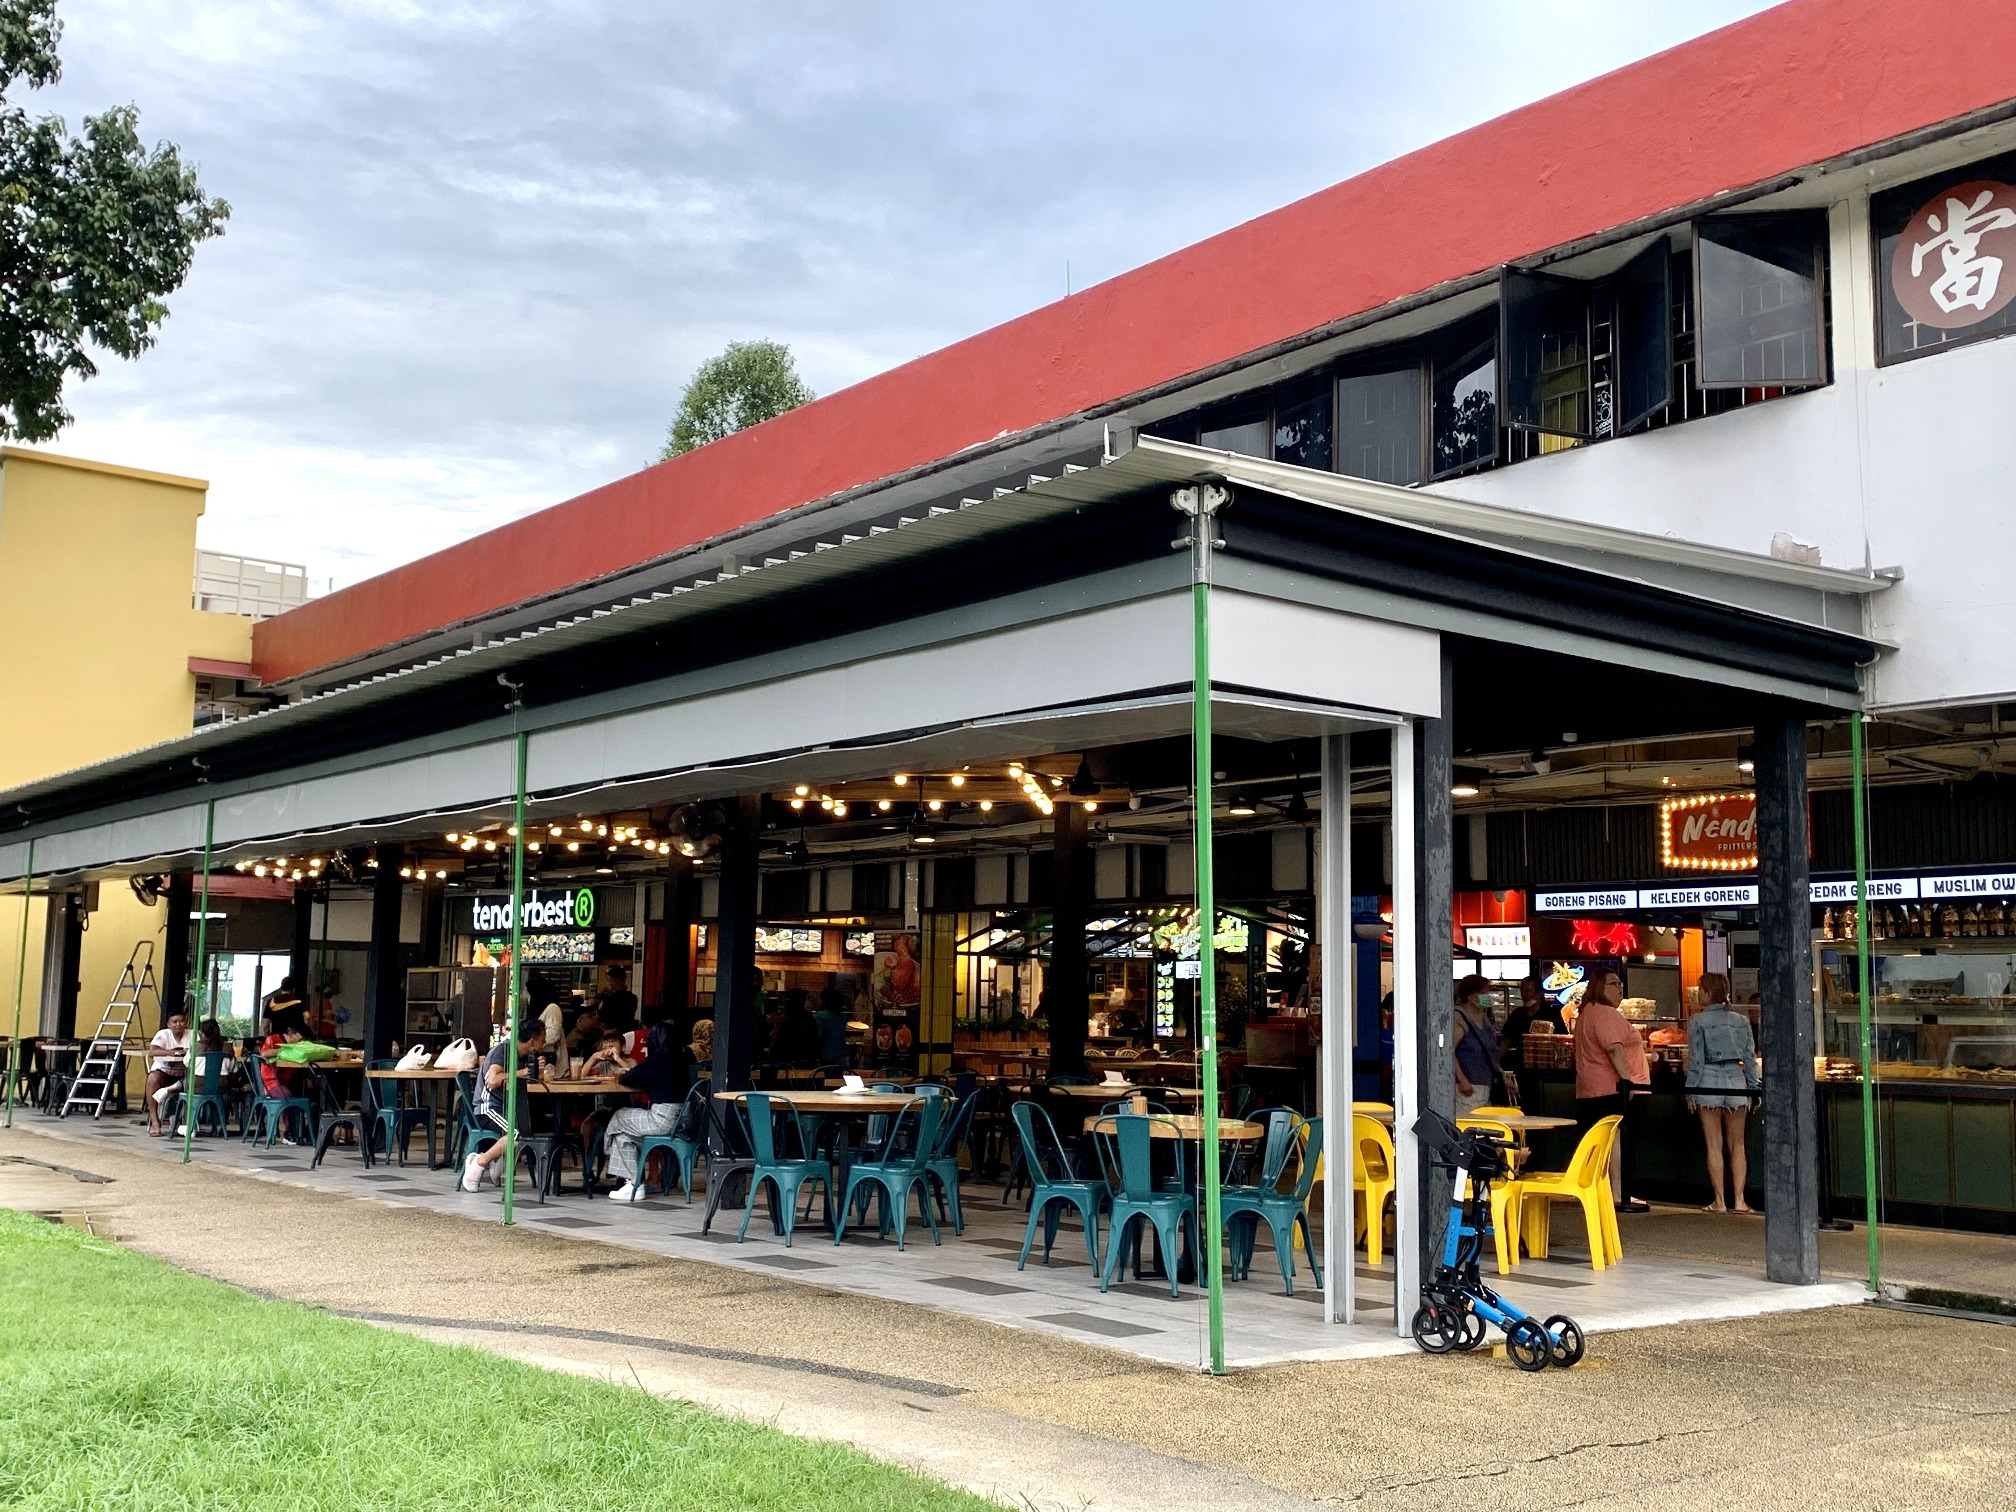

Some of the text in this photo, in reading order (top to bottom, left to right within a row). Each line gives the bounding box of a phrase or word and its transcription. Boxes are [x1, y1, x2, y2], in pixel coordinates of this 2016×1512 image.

[1911, 190, 2016, 313] 當
[1682, 807, 1758, 844] Nend
[1718, 842, 1758, 851] FRITTERS
[1934, 878, 1987, 894] MUSLIM
[1545, 895, 1626, 907] GORENG PISANG
[1650, 889, 1750, 905] KELEDEK GORENG
